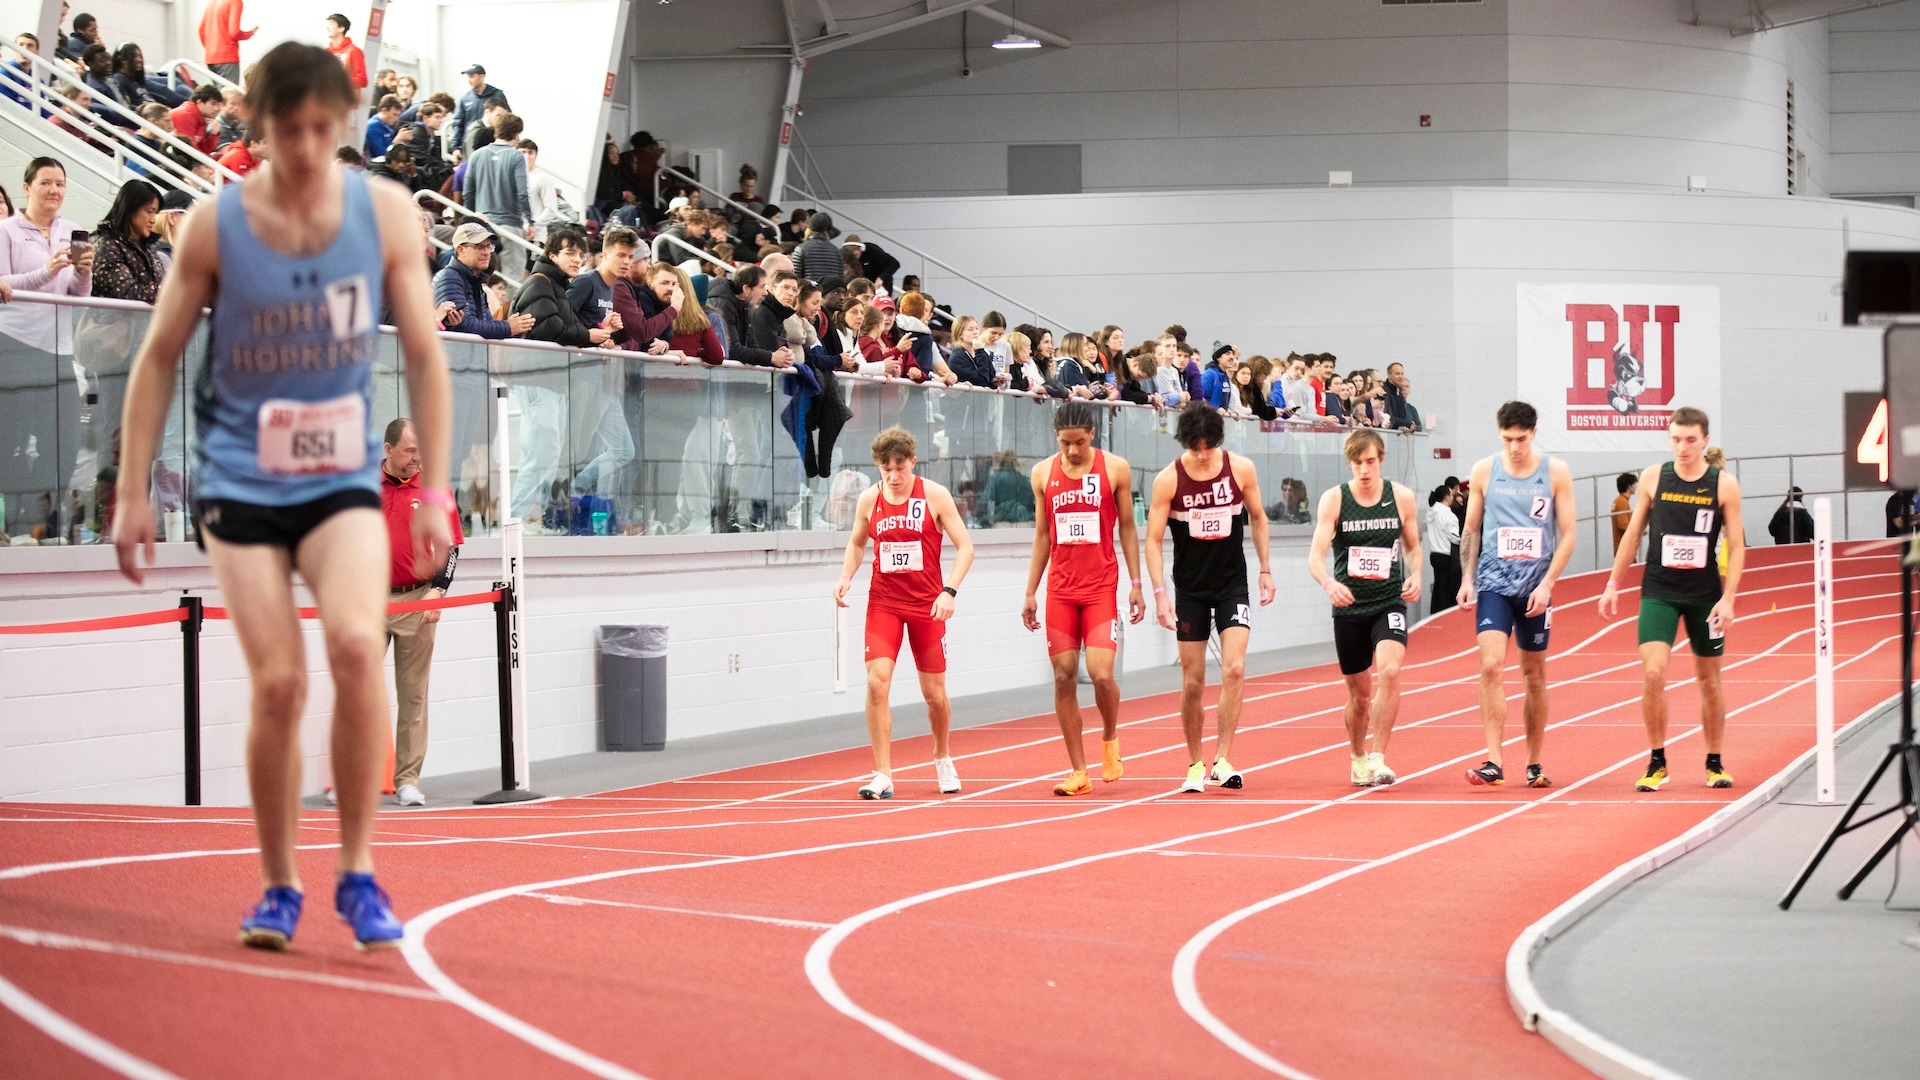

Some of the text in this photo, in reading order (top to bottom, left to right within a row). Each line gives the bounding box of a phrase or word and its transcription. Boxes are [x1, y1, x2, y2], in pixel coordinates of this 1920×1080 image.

[337, 285, 357, 330] 7
[252, 301, 332, 337] JOHN
[1565, 303, 1680, 405] BU
[1570, 415, 1671, 427] BOSTON UNIVERSITY
[292, 430, 335, 459] 651
[1857, 398, 1889, 483] 4
[1087, 476, 1096, 495] 5
[1217, 483, 1228, 503] 4
[1052, 489, 1102, 511] BOSTON
[1533, 498, 1545, 518] 2
[1660, 492, 1713, 506] BROCKPORT
[912, 500, 922, 519] 6
[876, 515, 923, 536] BOSTON
[1069, 524, 1085, 536] 181
[1202, 520, 1220, 532] 123
[1342, 517, 1399, 532] DARTMOUTH
[1701, 512, 1709, 532] 1
[1506, 538, 1533, 551] 1084
[1673, 548, 1694, 560] 228
[892, 553, 909, 566] 197
[1359, 558, 1380, 571] 395
[1818, 540, 1828, 657] FINISH
[510, 557, 519, 669] FINISH
[1241, 606, 1249, 624] 4
[1392, 613, 1401, 627] 3
